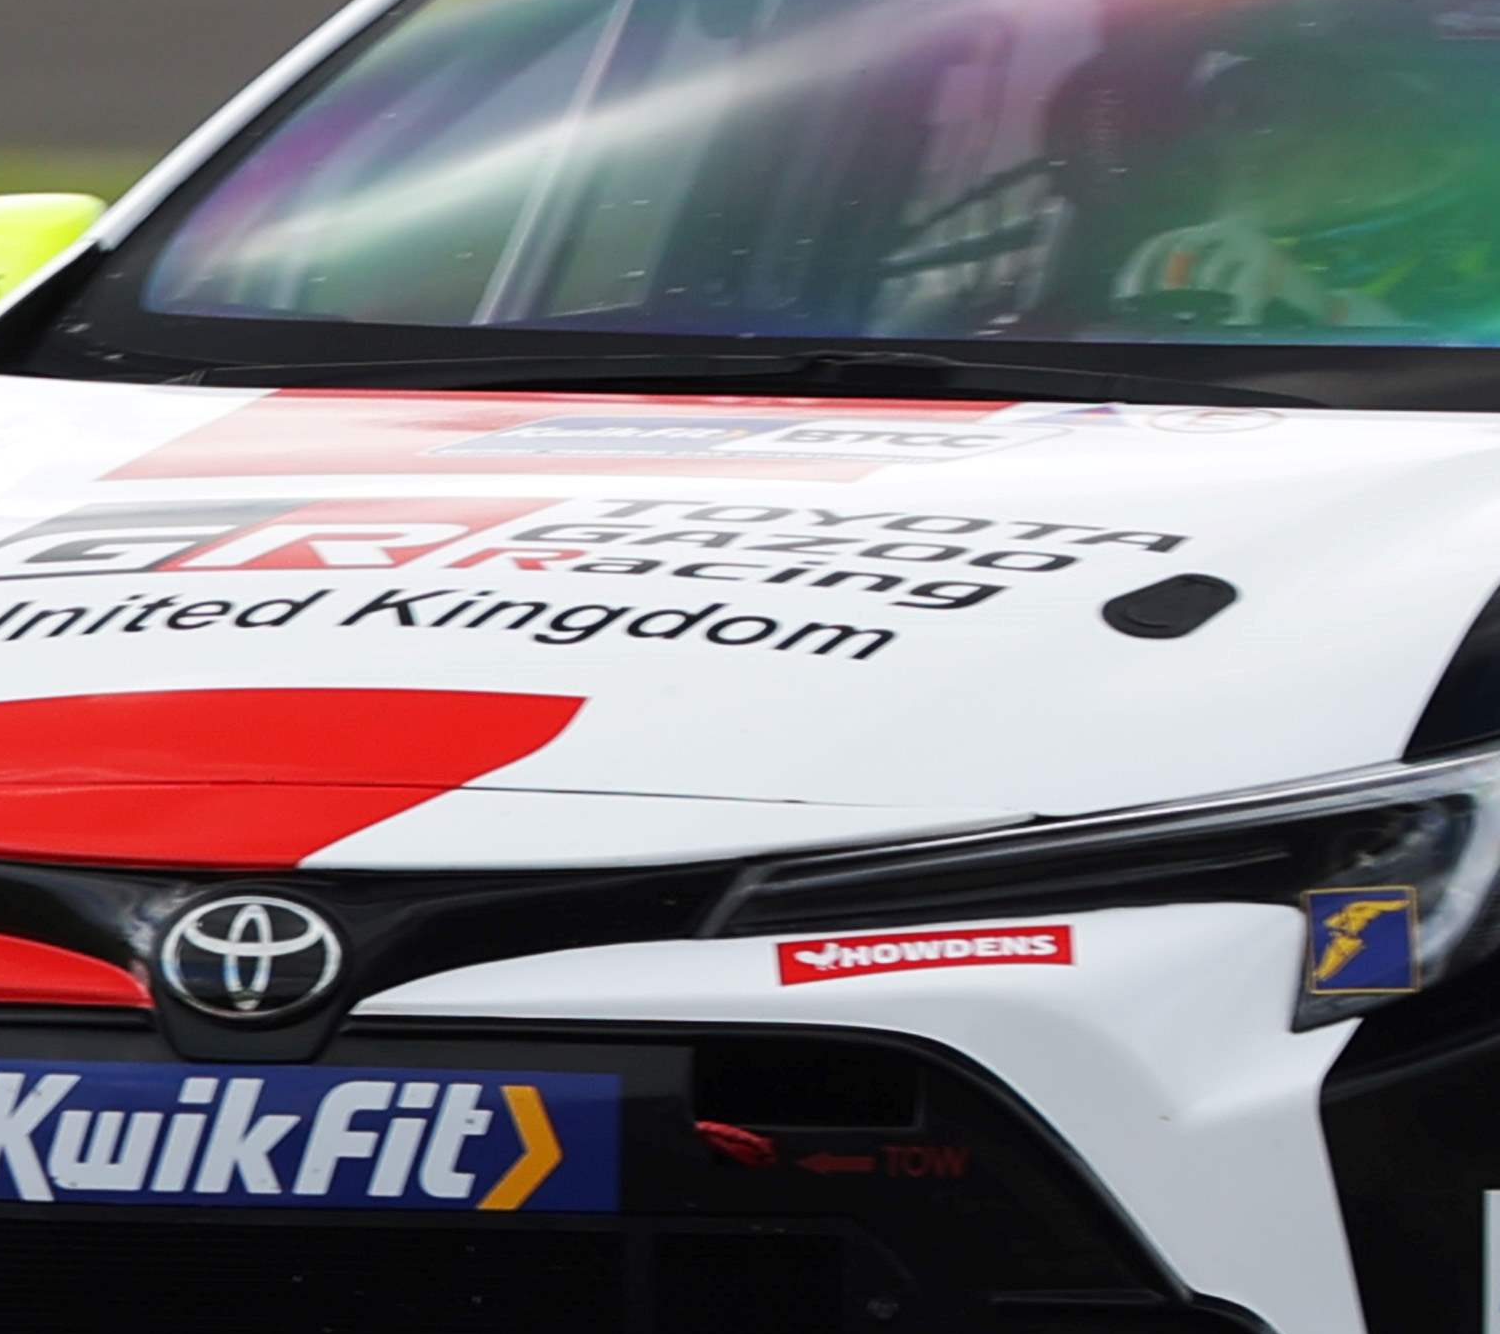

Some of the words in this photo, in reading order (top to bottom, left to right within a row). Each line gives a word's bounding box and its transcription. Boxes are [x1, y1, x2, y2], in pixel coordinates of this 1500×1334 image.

[776, 429, 1006, 450] BTCC
[506, 522, 1084, 574] GAZOO
[598, 498, 1193, 554] TOYOTA
[441, 547, 1011, 610] Racing
[339, 587, 897, 662] Kingdom
[840, 933, 1058, 969] HOWDENS
[882, 1146, 969, 1178] TOW
